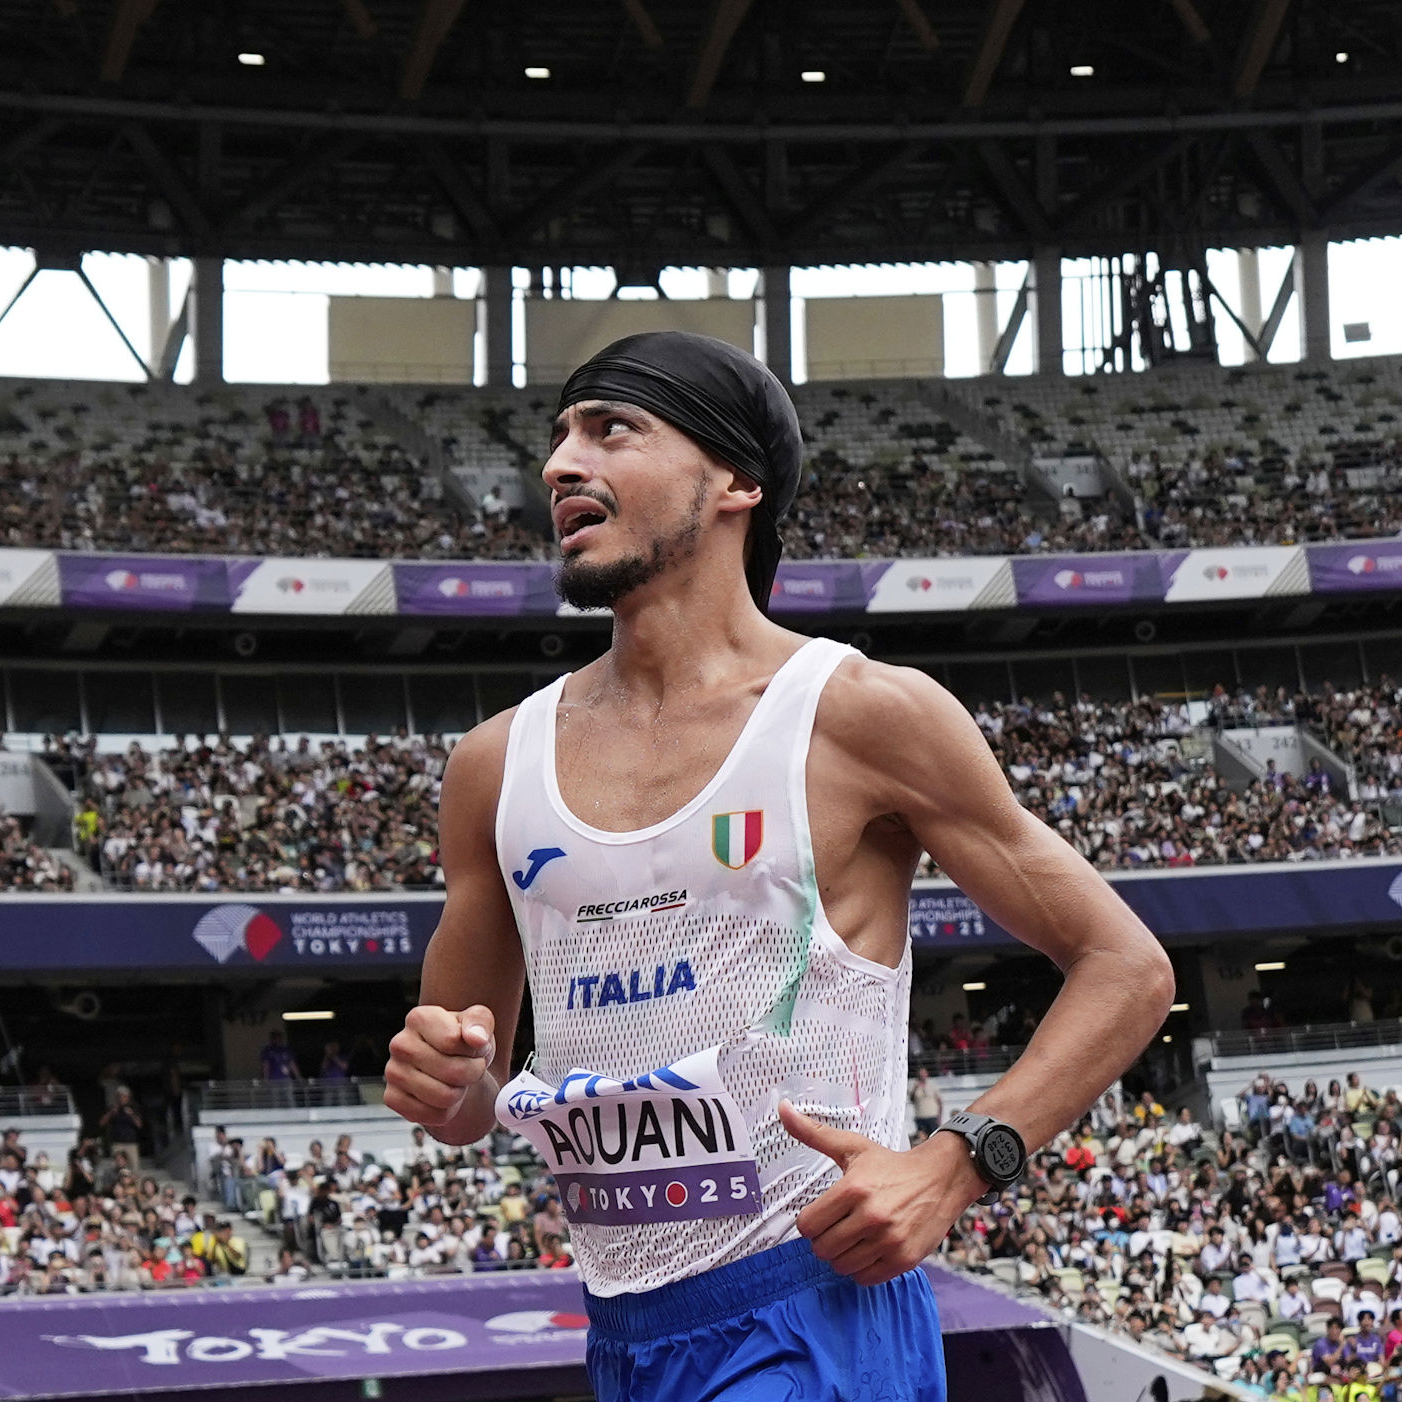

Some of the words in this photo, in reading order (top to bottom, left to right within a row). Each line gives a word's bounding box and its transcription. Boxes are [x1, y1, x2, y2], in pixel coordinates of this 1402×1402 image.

[577, 889, 687, 917] FRECCIAROSSA
[566, 959, 698, 1010] ITALIA
[539, 1097, 736, 1167] AOUANI
[589, 1180, 689, 1212] TOKYO
[700, 1175, 749, 1204] 25
[39, 1323, 468, 1366] TOKYO
